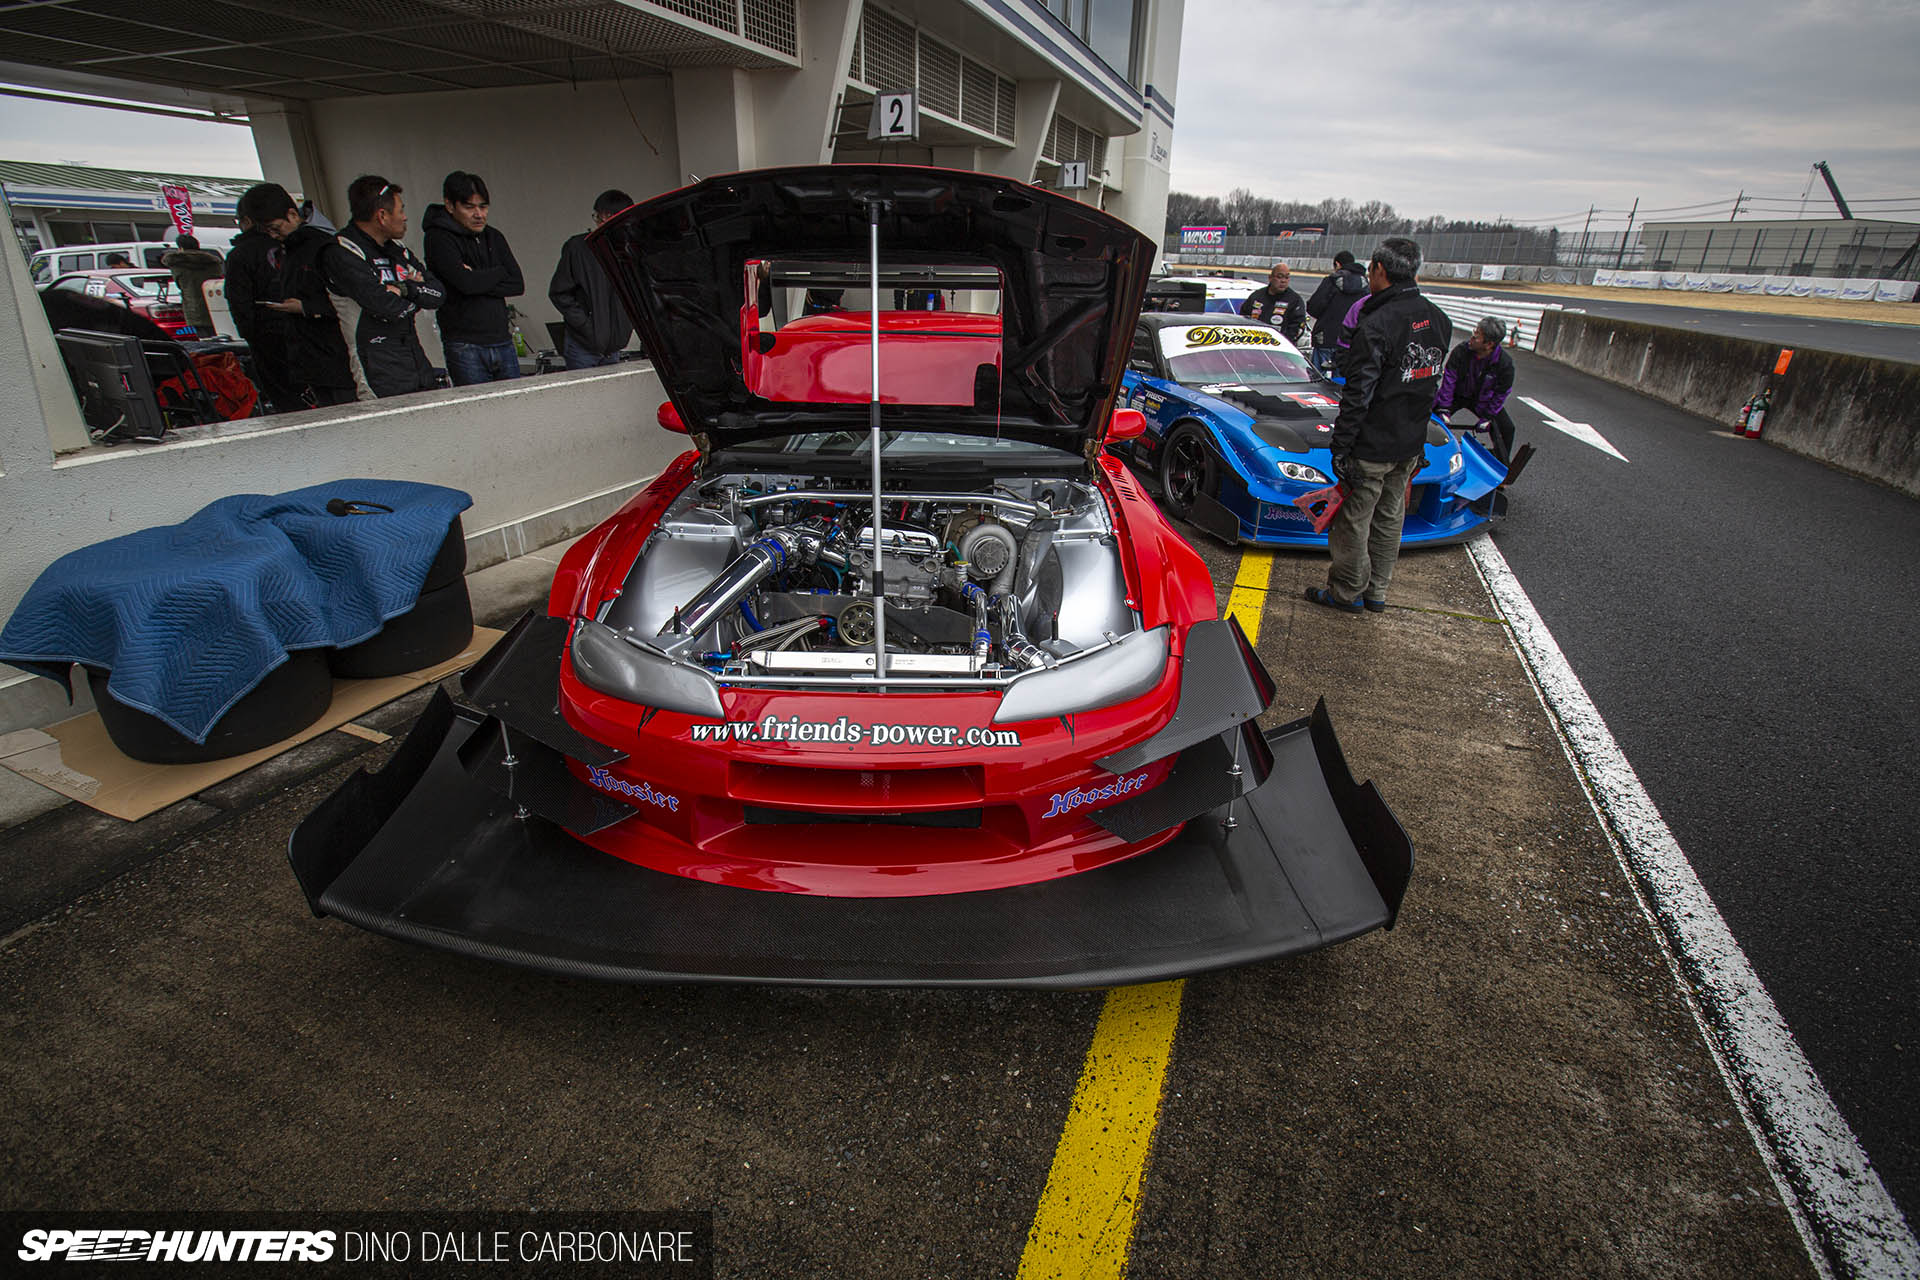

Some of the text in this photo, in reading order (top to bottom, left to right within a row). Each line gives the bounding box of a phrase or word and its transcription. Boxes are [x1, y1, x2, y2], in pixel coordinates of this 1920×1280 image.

[889, 98, 905, 133] 2
[1071, 164, 1078, 185] 1
[175, 326, 198, 336] alli
[1185, 326, 1281, 349] Dream
[1145, 389, 1167, 404] TRUST
[691, 716, 1021, 747] www.friends-power.com
[586, 764, 680, 812] Hoosier
[1041, 773, 1149, 819] Hoosier
